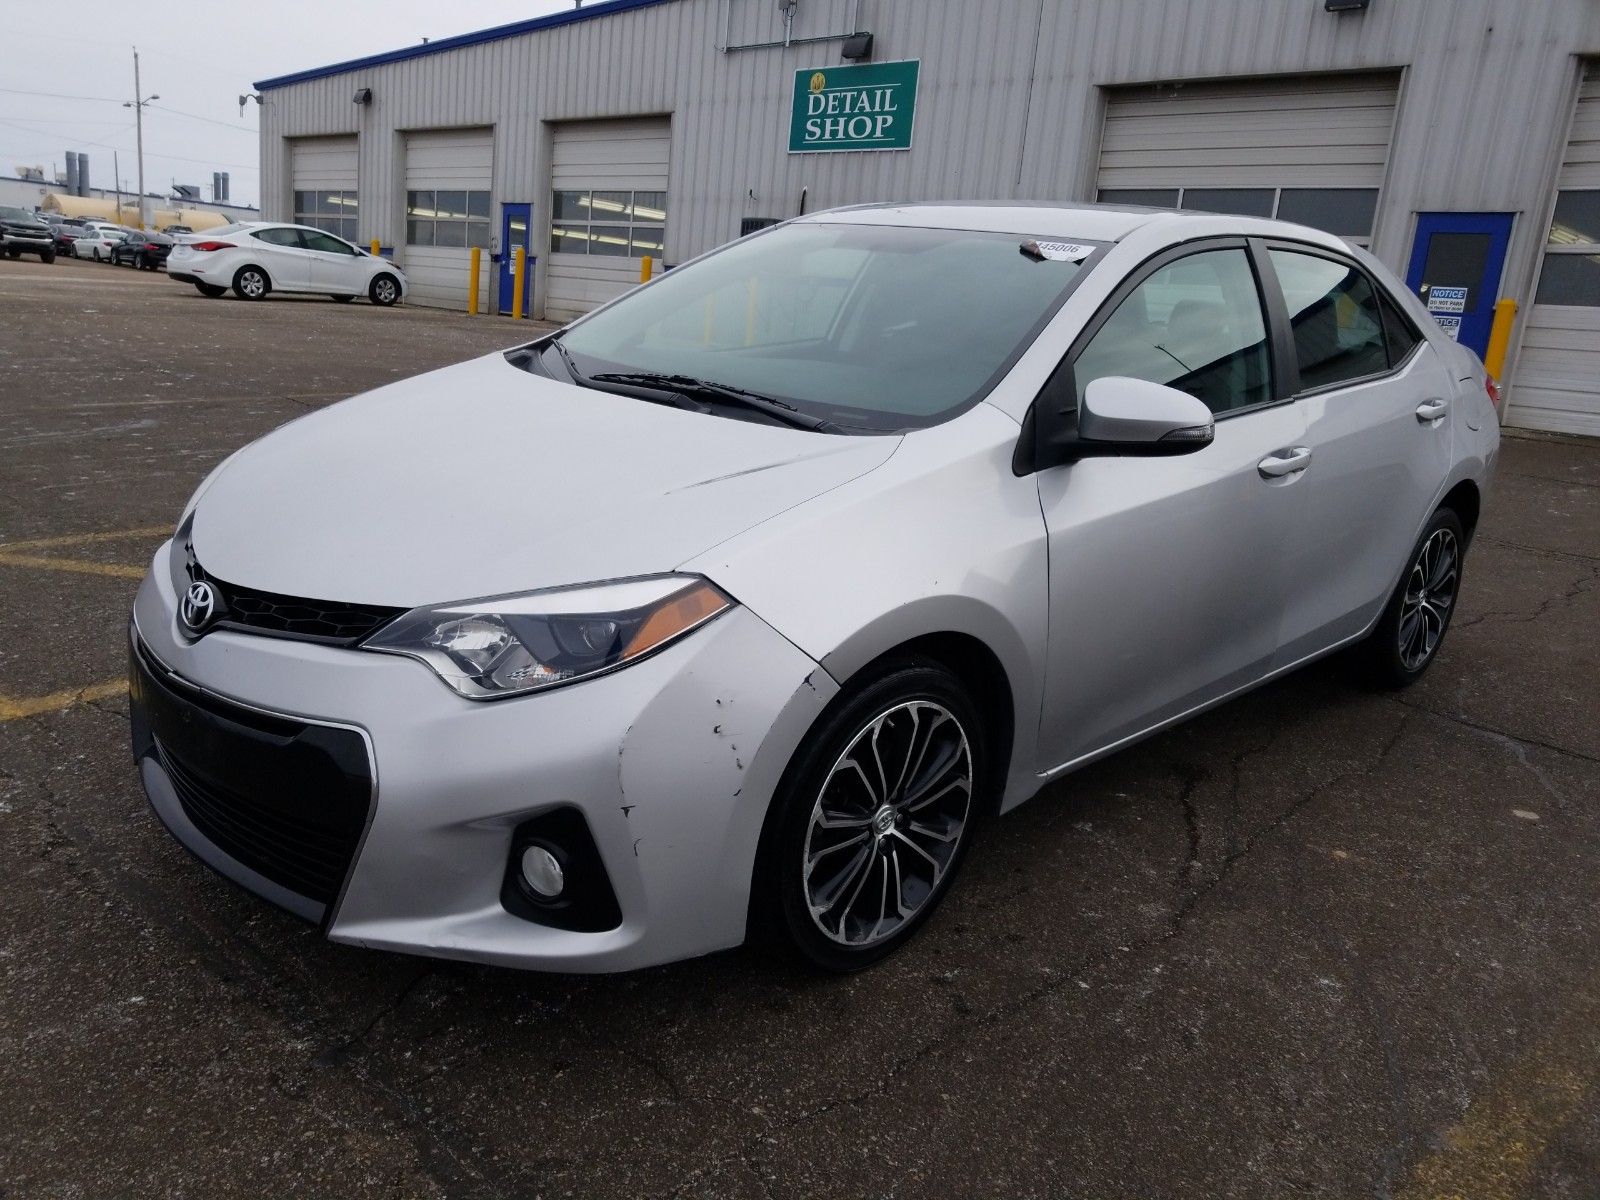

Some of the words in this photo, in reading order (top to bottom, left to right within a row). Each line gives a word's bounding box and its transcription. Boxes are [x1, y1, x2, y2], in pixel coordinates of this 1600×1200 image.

[807, 89, 898, 115] DETAIL
[805, 115, 894, 140] SHOP
[1432, 289, 1464, 298] NOTICE
